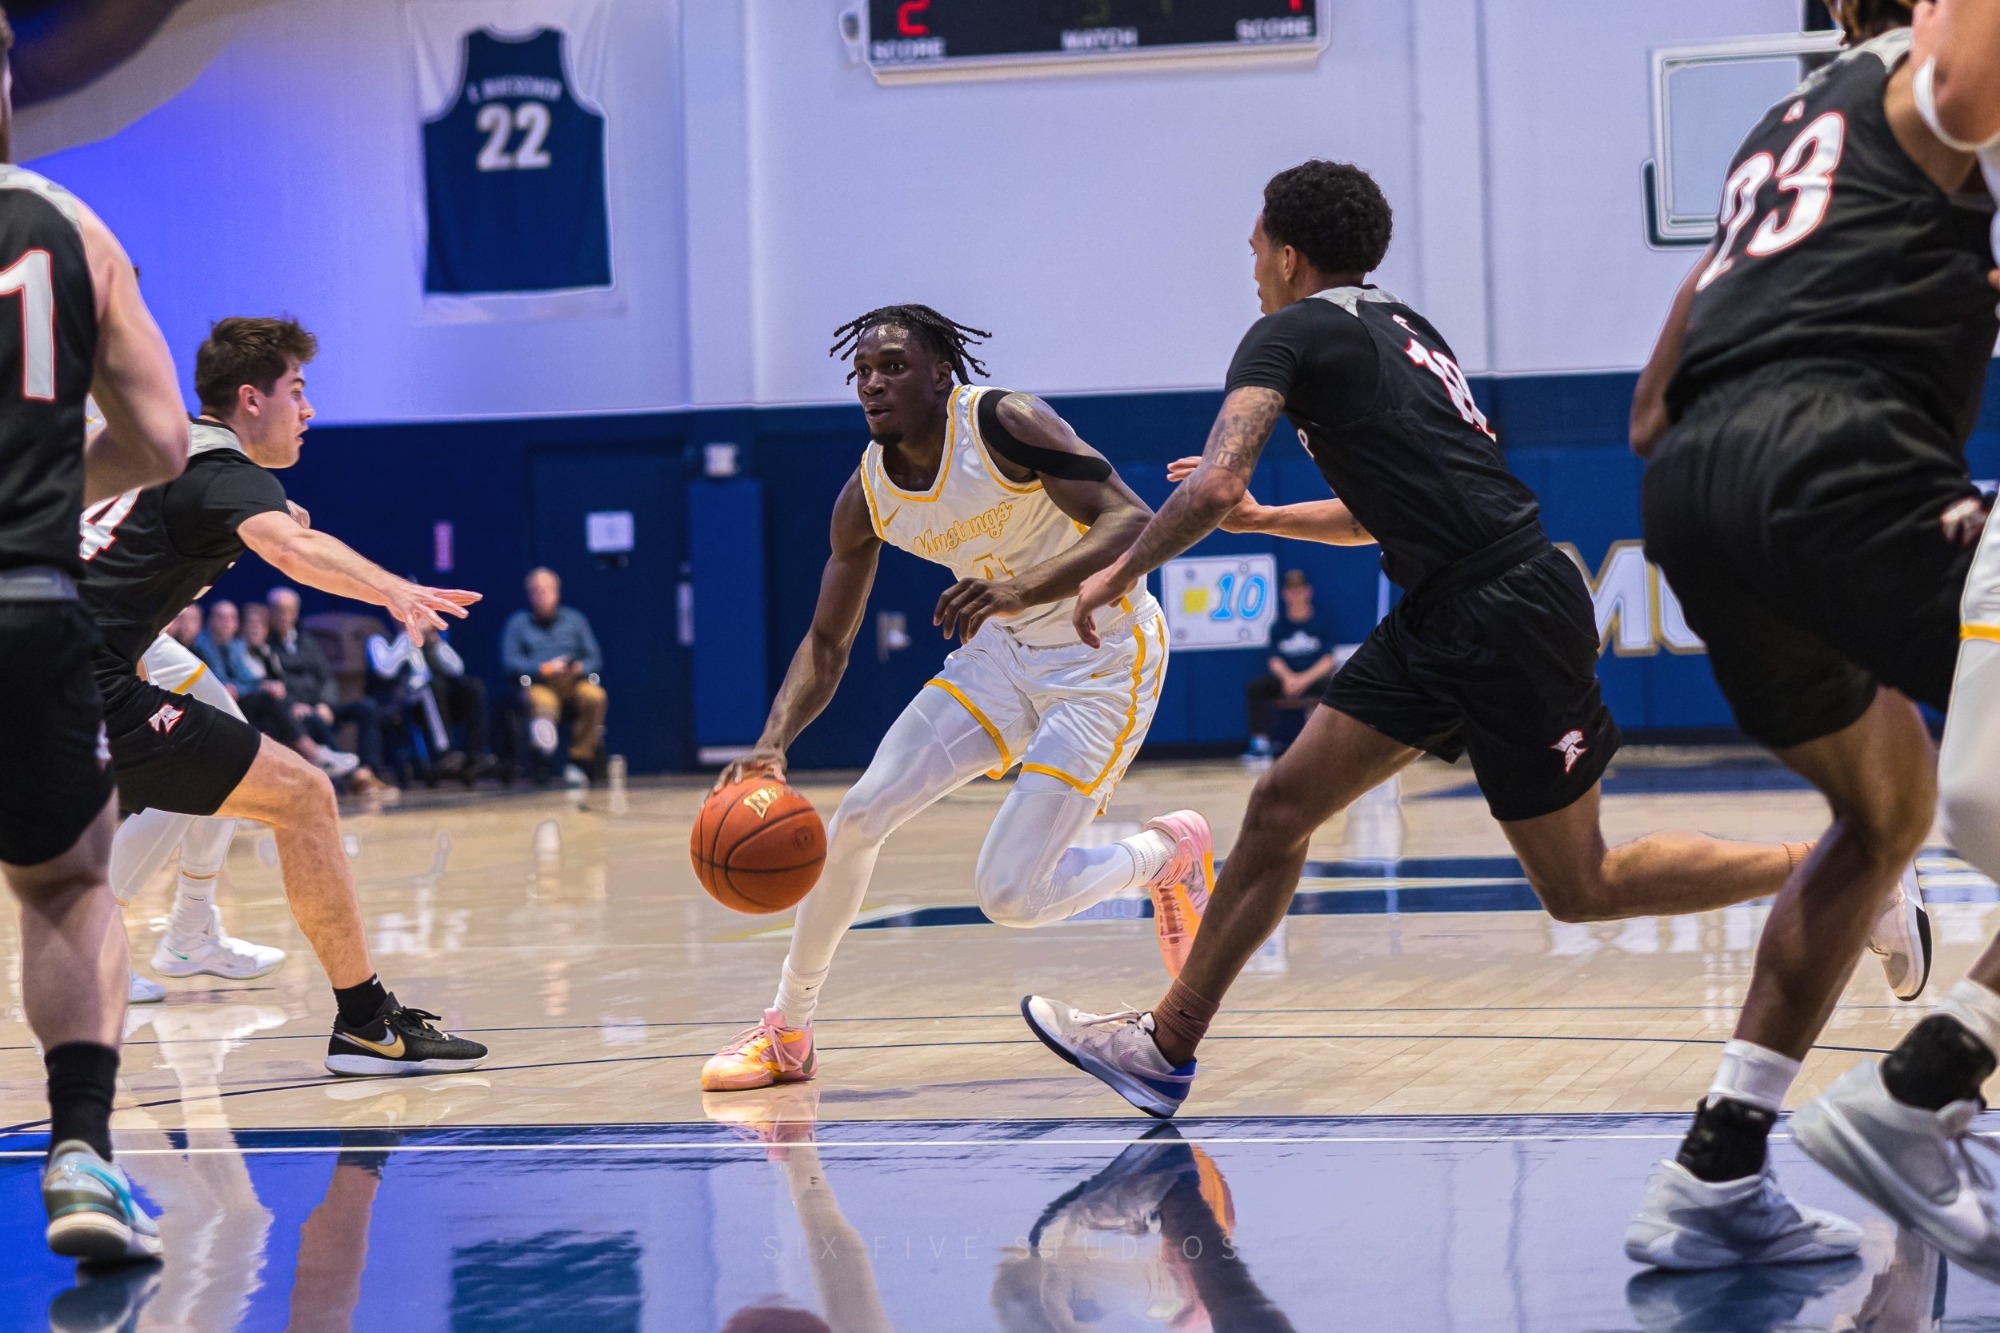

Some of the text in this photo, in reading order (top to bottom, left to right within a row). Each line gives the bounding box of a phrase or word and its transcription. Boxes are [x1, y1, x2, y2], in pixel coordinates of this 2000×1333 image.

[1235, 16, 1313, 41] SCORE
[476, 102, 551, 172] 22
[1696, 111, 1845, 292] 23
[914, 502, 1012, 557] Mustangs
[1210, 573, 1268, 621] 10
